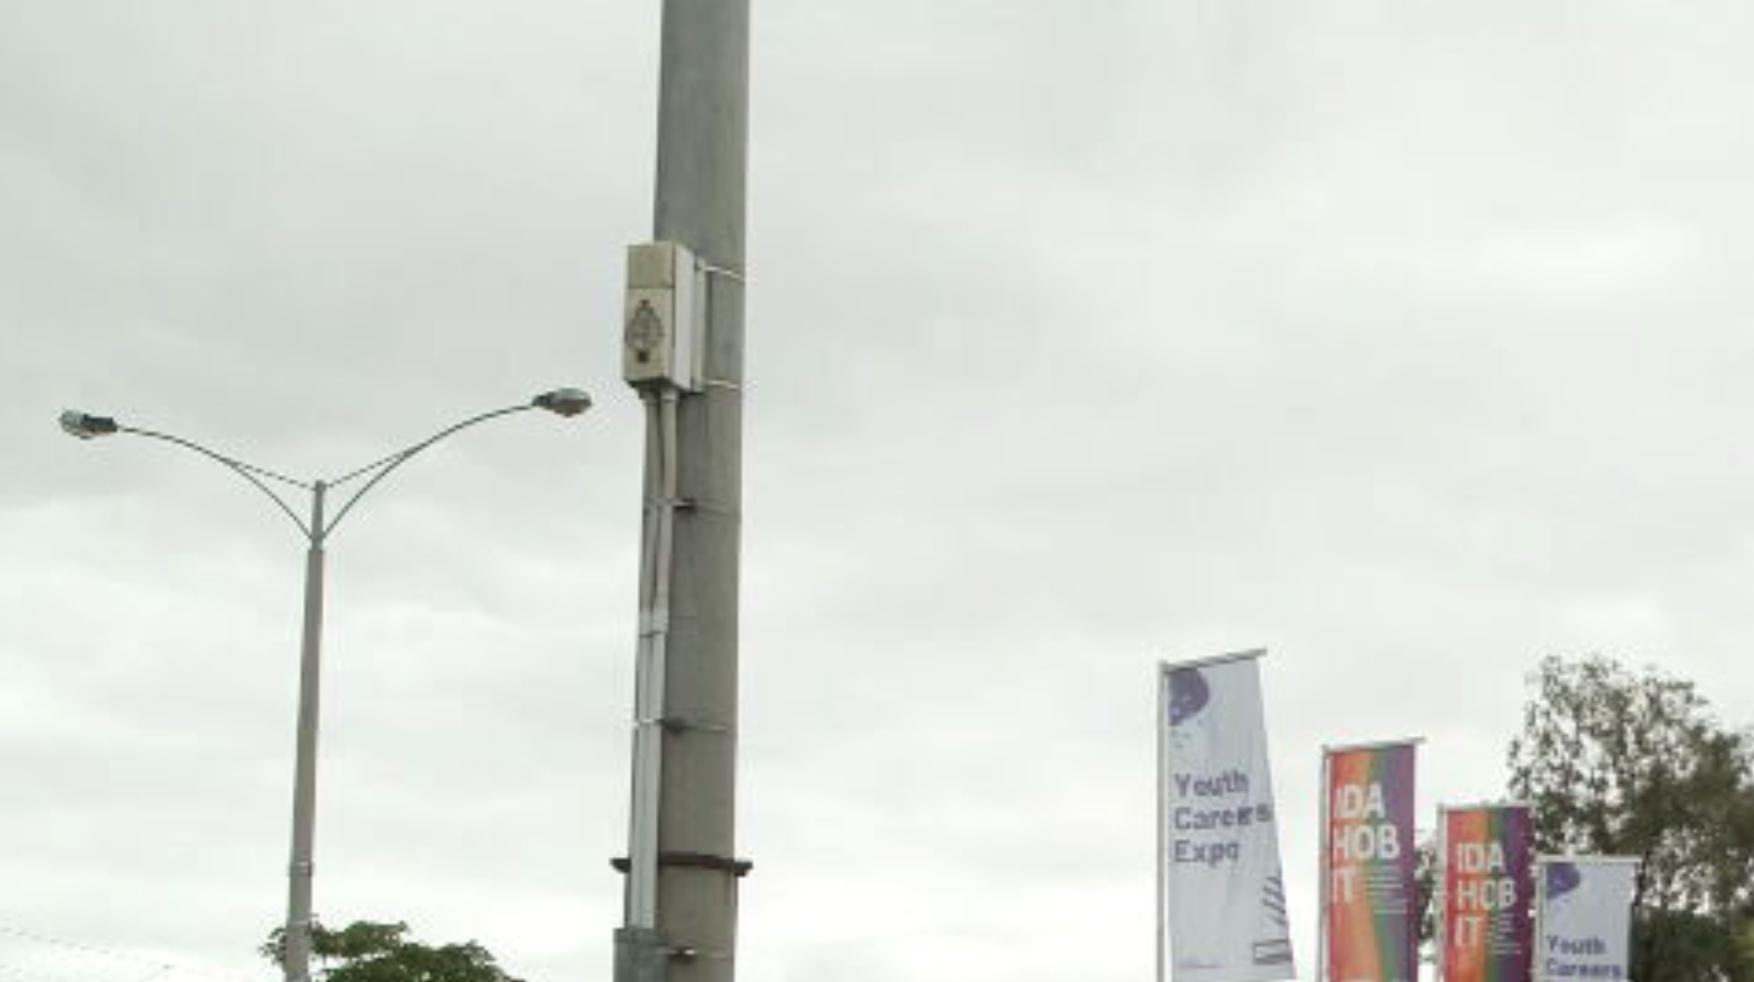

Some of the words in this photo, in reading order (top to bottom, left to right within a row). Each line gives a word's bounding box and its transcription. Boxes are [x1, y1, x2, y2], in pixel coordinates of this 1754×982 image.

[1175, 770, 1249, 797] Youth
[1175, 803, 1274, 830] Careers
[1175, 840, 1239, 869] Expo
[1333, 824, 1401, 860] HOB
[1333, 866, 1357, 905] IT
[1458, 877, 1518, 911] HOB
[1456, 914, 1484, 947] IT
[1546, 935, 1606, 955] Youth
[1546, 958, 1621, 980] Careers
